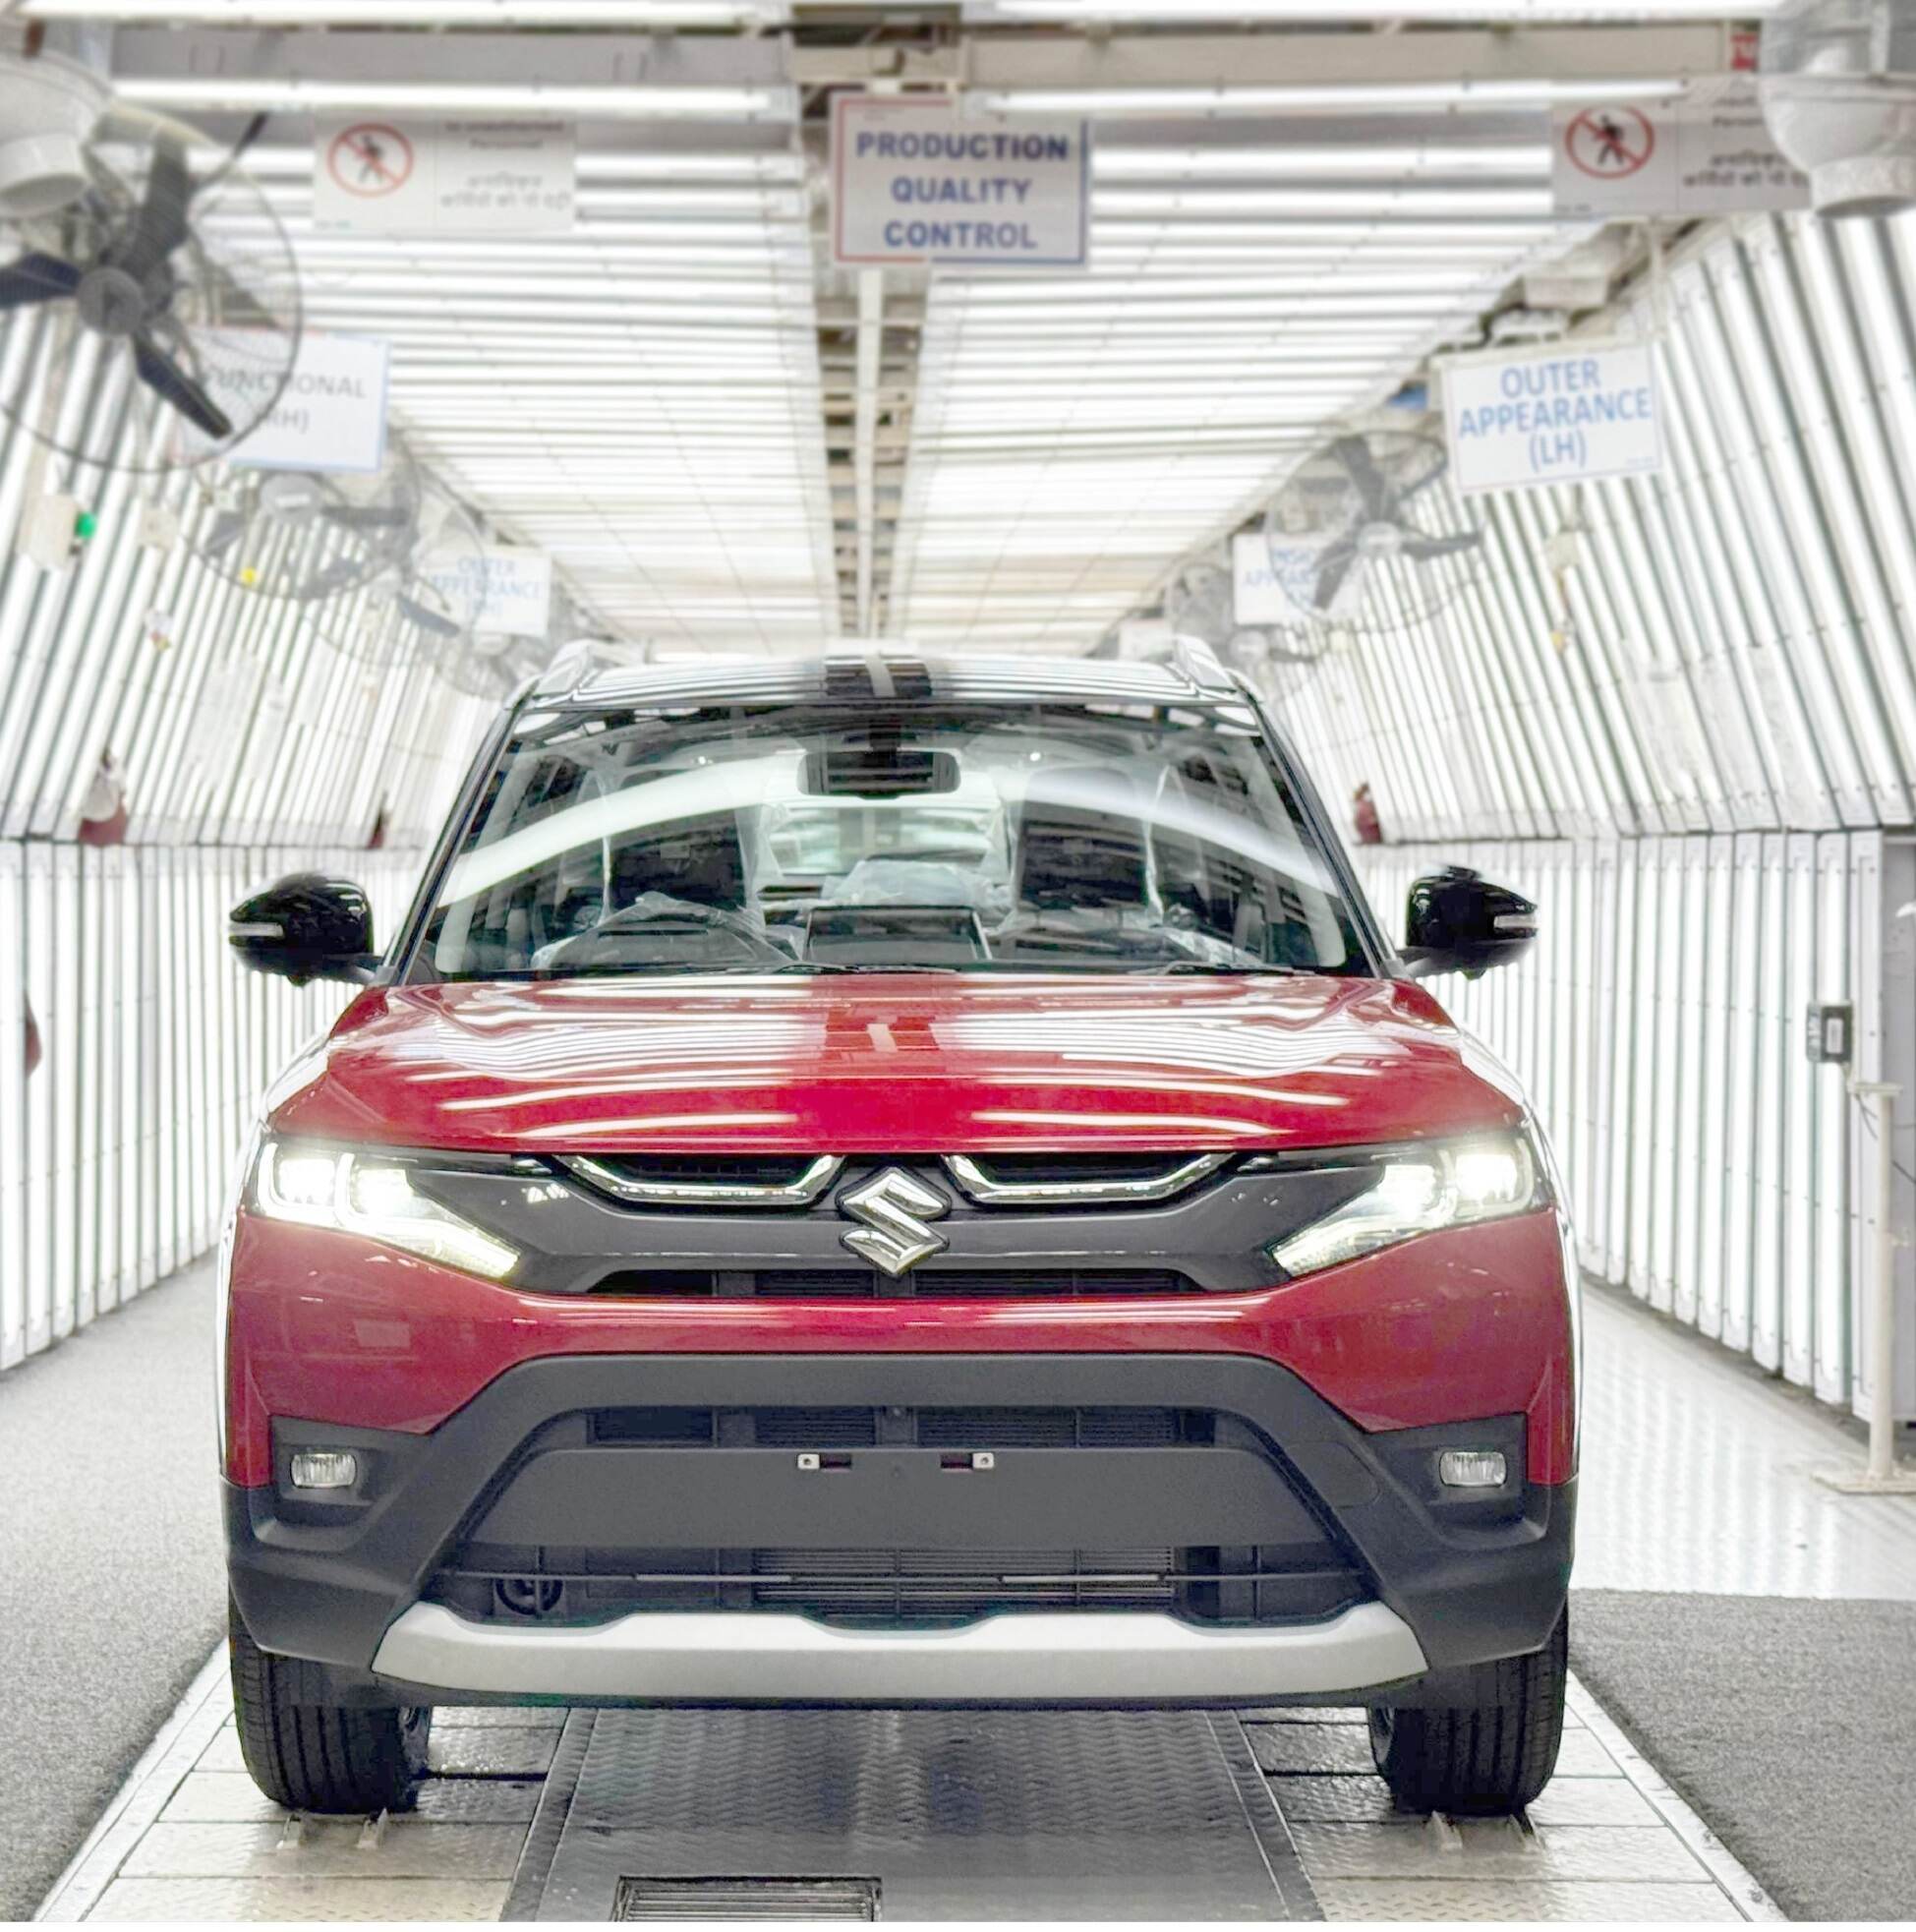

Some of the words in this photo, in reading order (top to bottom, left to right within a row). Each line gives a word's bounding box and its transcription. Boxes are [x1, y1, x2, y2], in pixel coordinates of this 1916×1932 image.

[855, 131, 1069, 160] PRODUCTION
[890, 176, 1032, 204] QUALITY
[884, 220, 1038, 250] CONTROL
[1500, 357, 1602, 398] OUTER
[1458, 386, 1654, 439] APPEARANCE
[1529, 427, 1588, 474] (LH)
